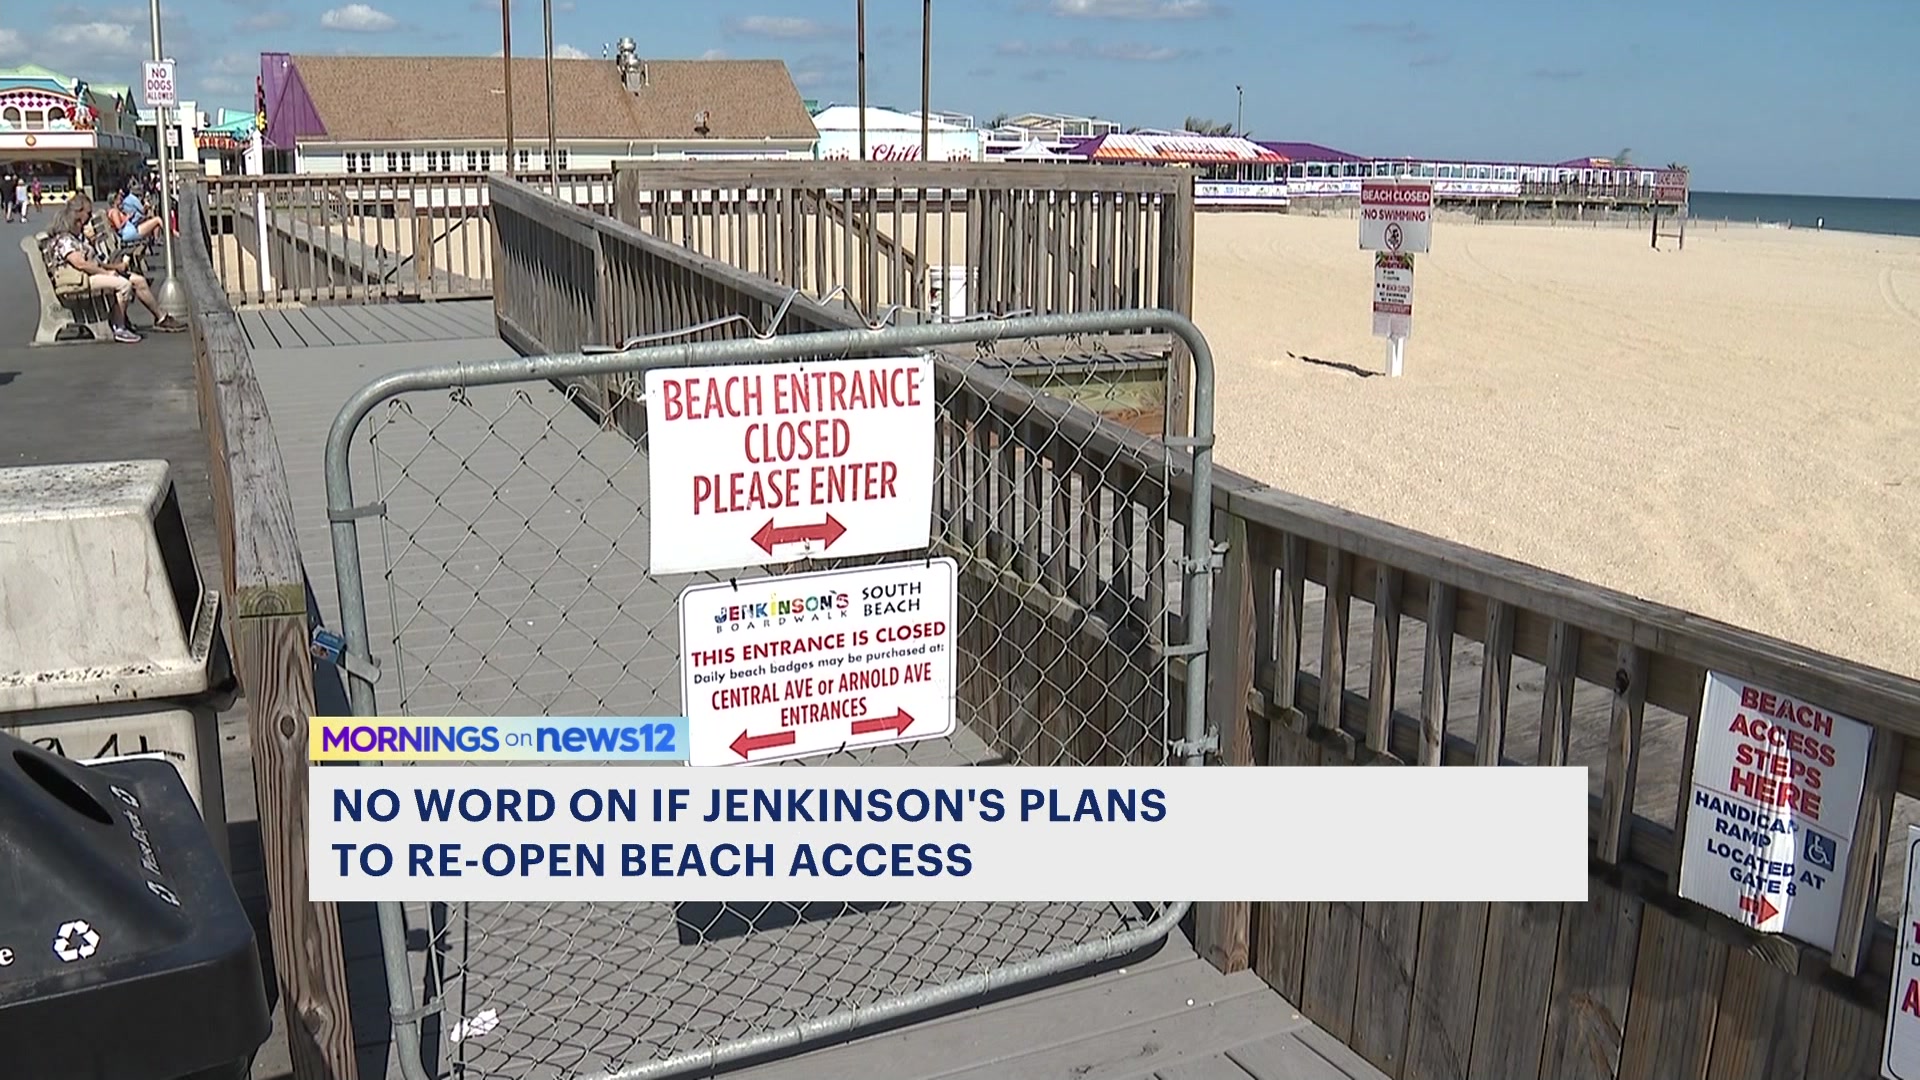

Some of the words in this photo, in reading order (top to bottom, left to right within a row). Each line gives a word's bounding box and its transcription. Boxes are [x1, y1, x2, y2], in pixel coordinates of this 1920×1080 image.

[147, 81, 172, 91] DOGS
[152, 68, 167, 79] NO
[147, 92, 173, 101] ALLOWED
[872, 144, 923, 162] Chill
[1362, 190, 1392, 201] BEACH
[1393, 190, 1430, 202] CLOSED
[1364, 209, 1377, 220] NO
[1379, 210, 1426, 222] SWIMMING
[663, 376, 762, 421] BEACH
[774, 367, 921, 415] ENTRANCE
[745, 418, 850, 464] CLOSED
[693, 468, 799, 515] PLEASE
[810, 461, 897, 505] ENTER
[862, 581, 922, 600] SOUTH
[717, 611, 848, 633] BOARDWALK
[863, 598, 920, 617] BEACH
[692, 647, 735, 667] THIS
[743, 633, 845, 661] ENTRANCE
[853, 630, 868, 646] IS
[876, 621, 946, 643] CLOSED
[694, 671, 725, 685] Daily
[730, 665, 766, 679] beach
[770, 660, 814, 675] badges
[818, 657, 844, 671] may
[848, 652, 862, 663] be
[866, 647, 926, 666] purchased
[929, 643, 945, 653] at:
[712, 683, 779, 711] CENTRAL
[784, 678, 813, 700] AVE
[818, 679, 834, 695] or
[839, 666, 898, 693] ARNOLD
[904, 662, 932, 684] AVE
[781, 697, 867, 727] ENTRANCES
[1741, 686, 1833, 738] BEACH
[1729, 713, 1836, 768] ACCESS
[1736, 743, 1822, 790] STEPS
[1730, 767, 1821, 821] HERE
[1715, 818, 1771, 848] RAMP
[1707, 838, 1795, 878] LOCATED
[1800, 870, 1826, 890] AT
[1730, 867, 1781, 894] GATE
[1786, 881, 1797, 896] 8
